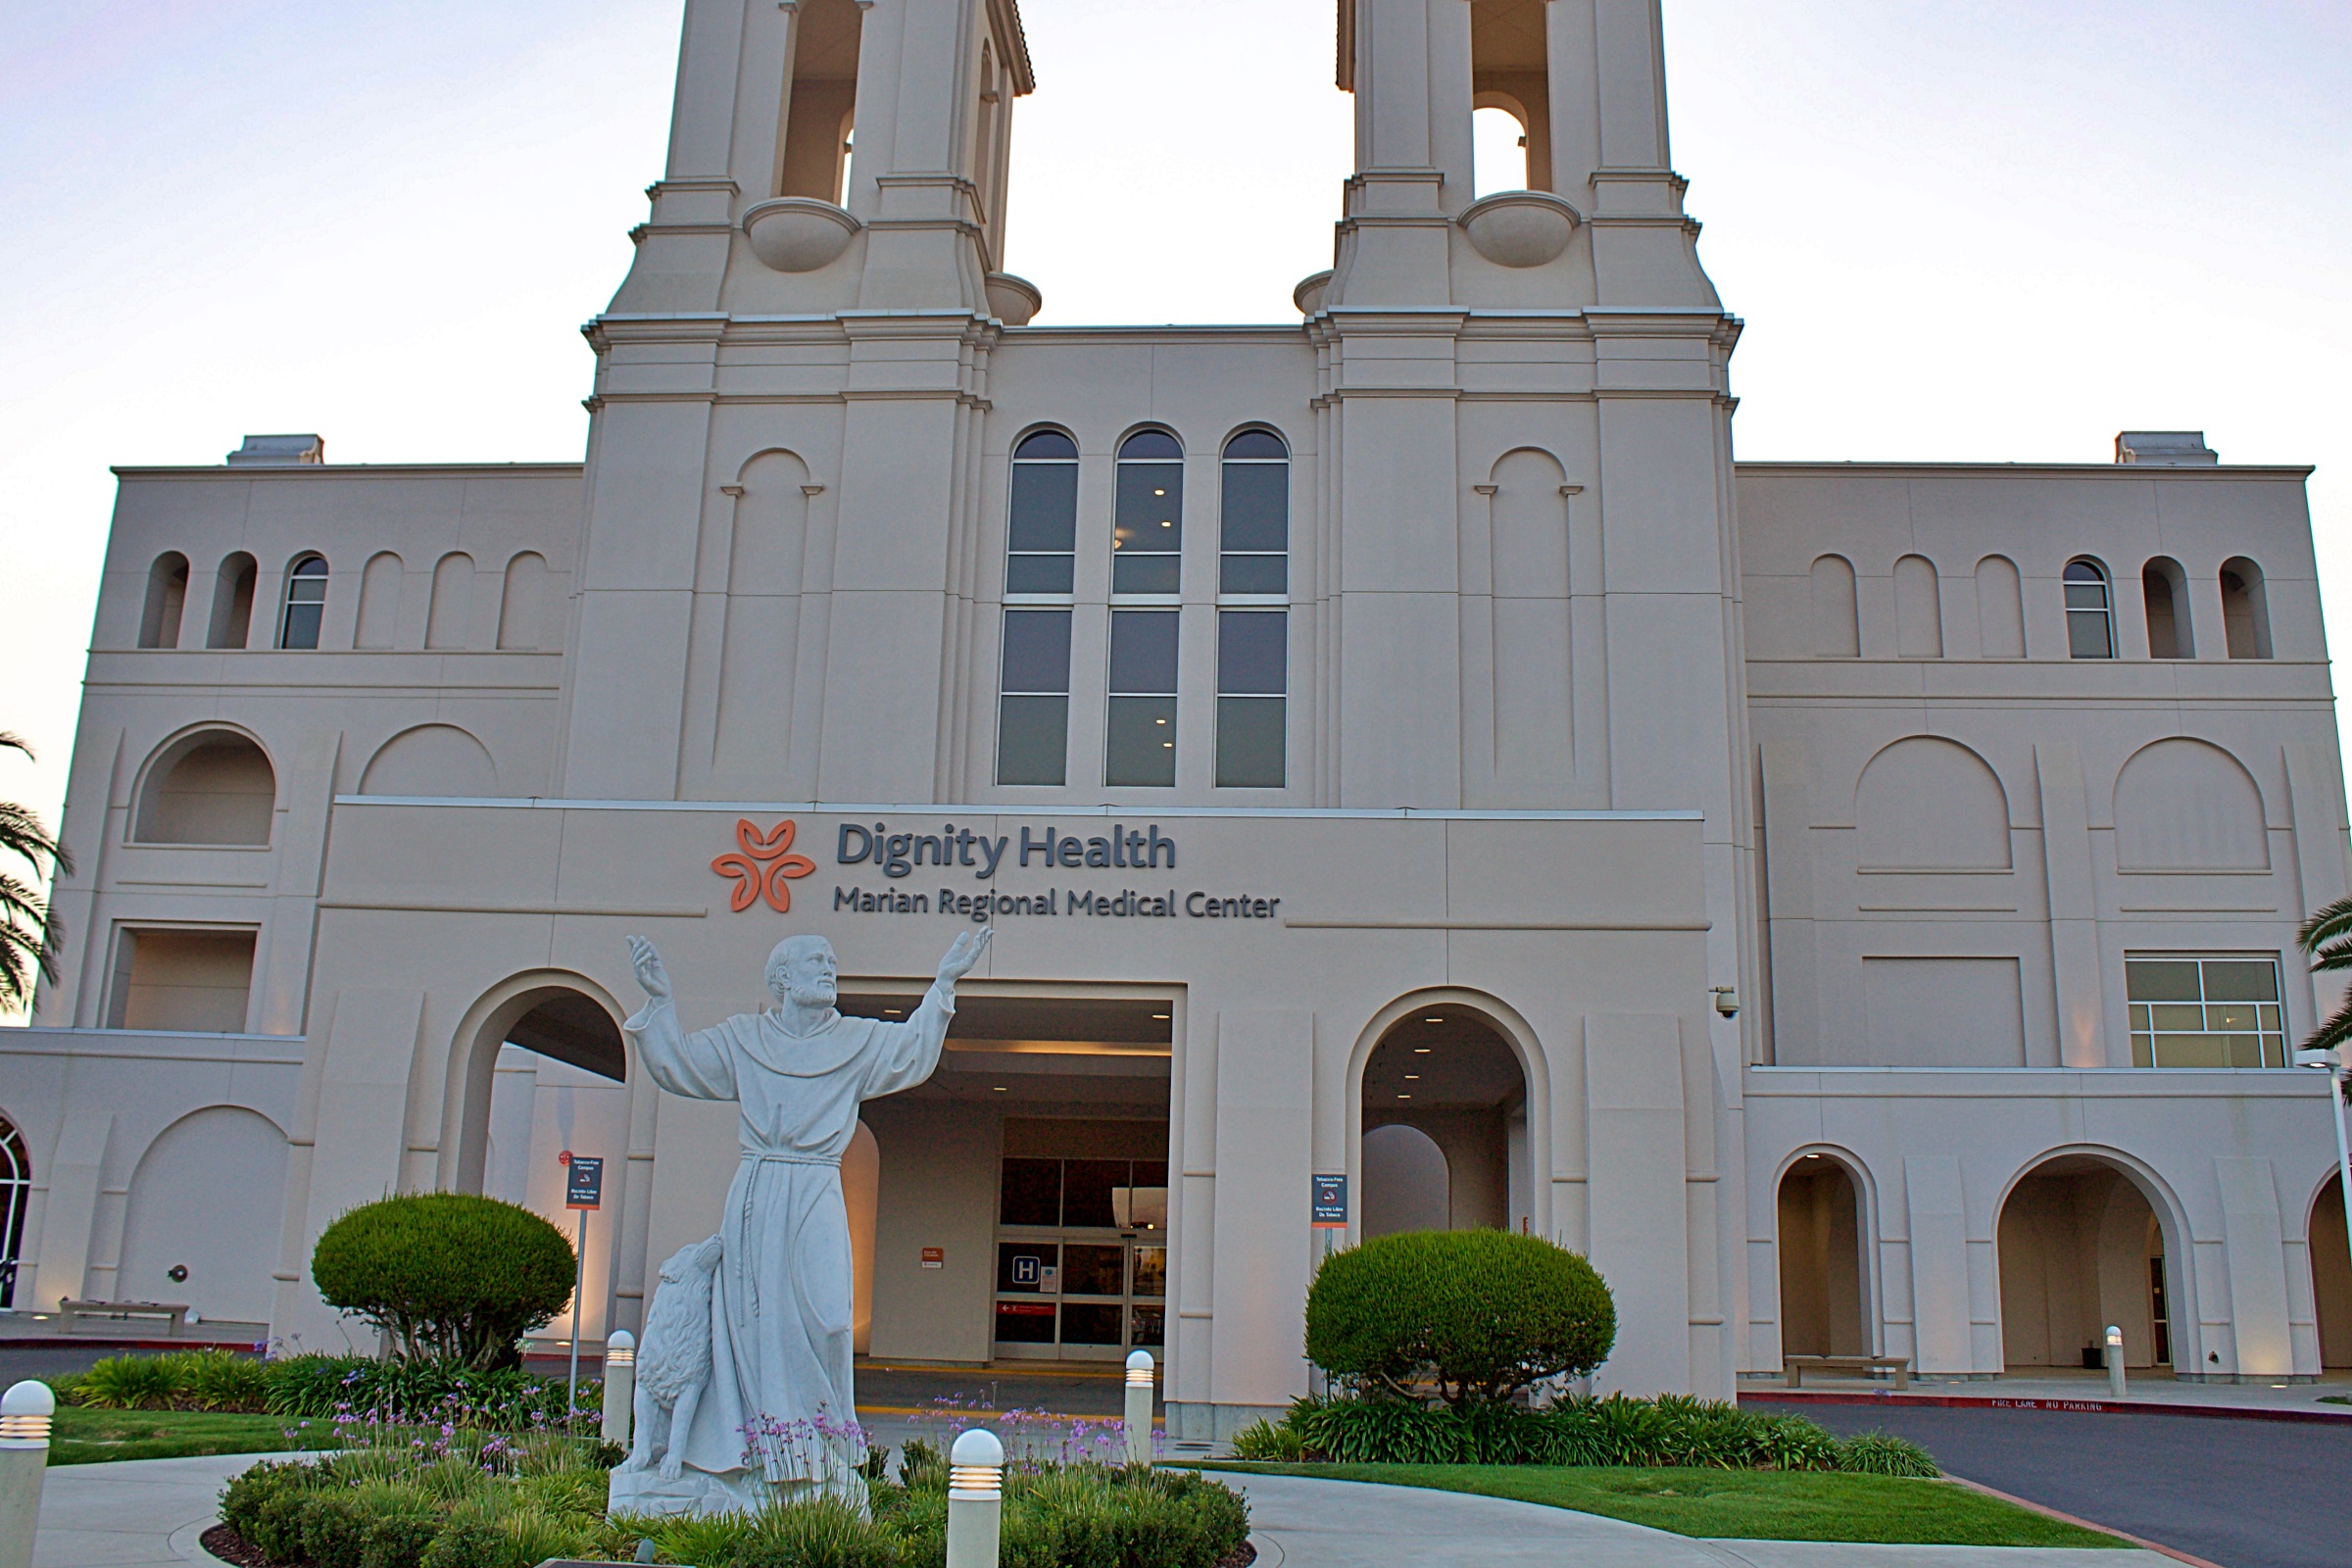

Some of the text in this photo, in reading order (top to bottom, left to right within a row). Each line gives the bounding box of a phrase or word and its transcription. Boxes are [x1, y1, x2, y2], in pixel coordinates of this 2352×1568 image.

[837, 821, 1175, 879] Dignity Health
[834, 886, 1280, 922] Marian Regional Medical Center
[1019, 1261, 1033, 1279] H
[1991, 1398, 2102, 1410] FIRE LANE NO PARKING
